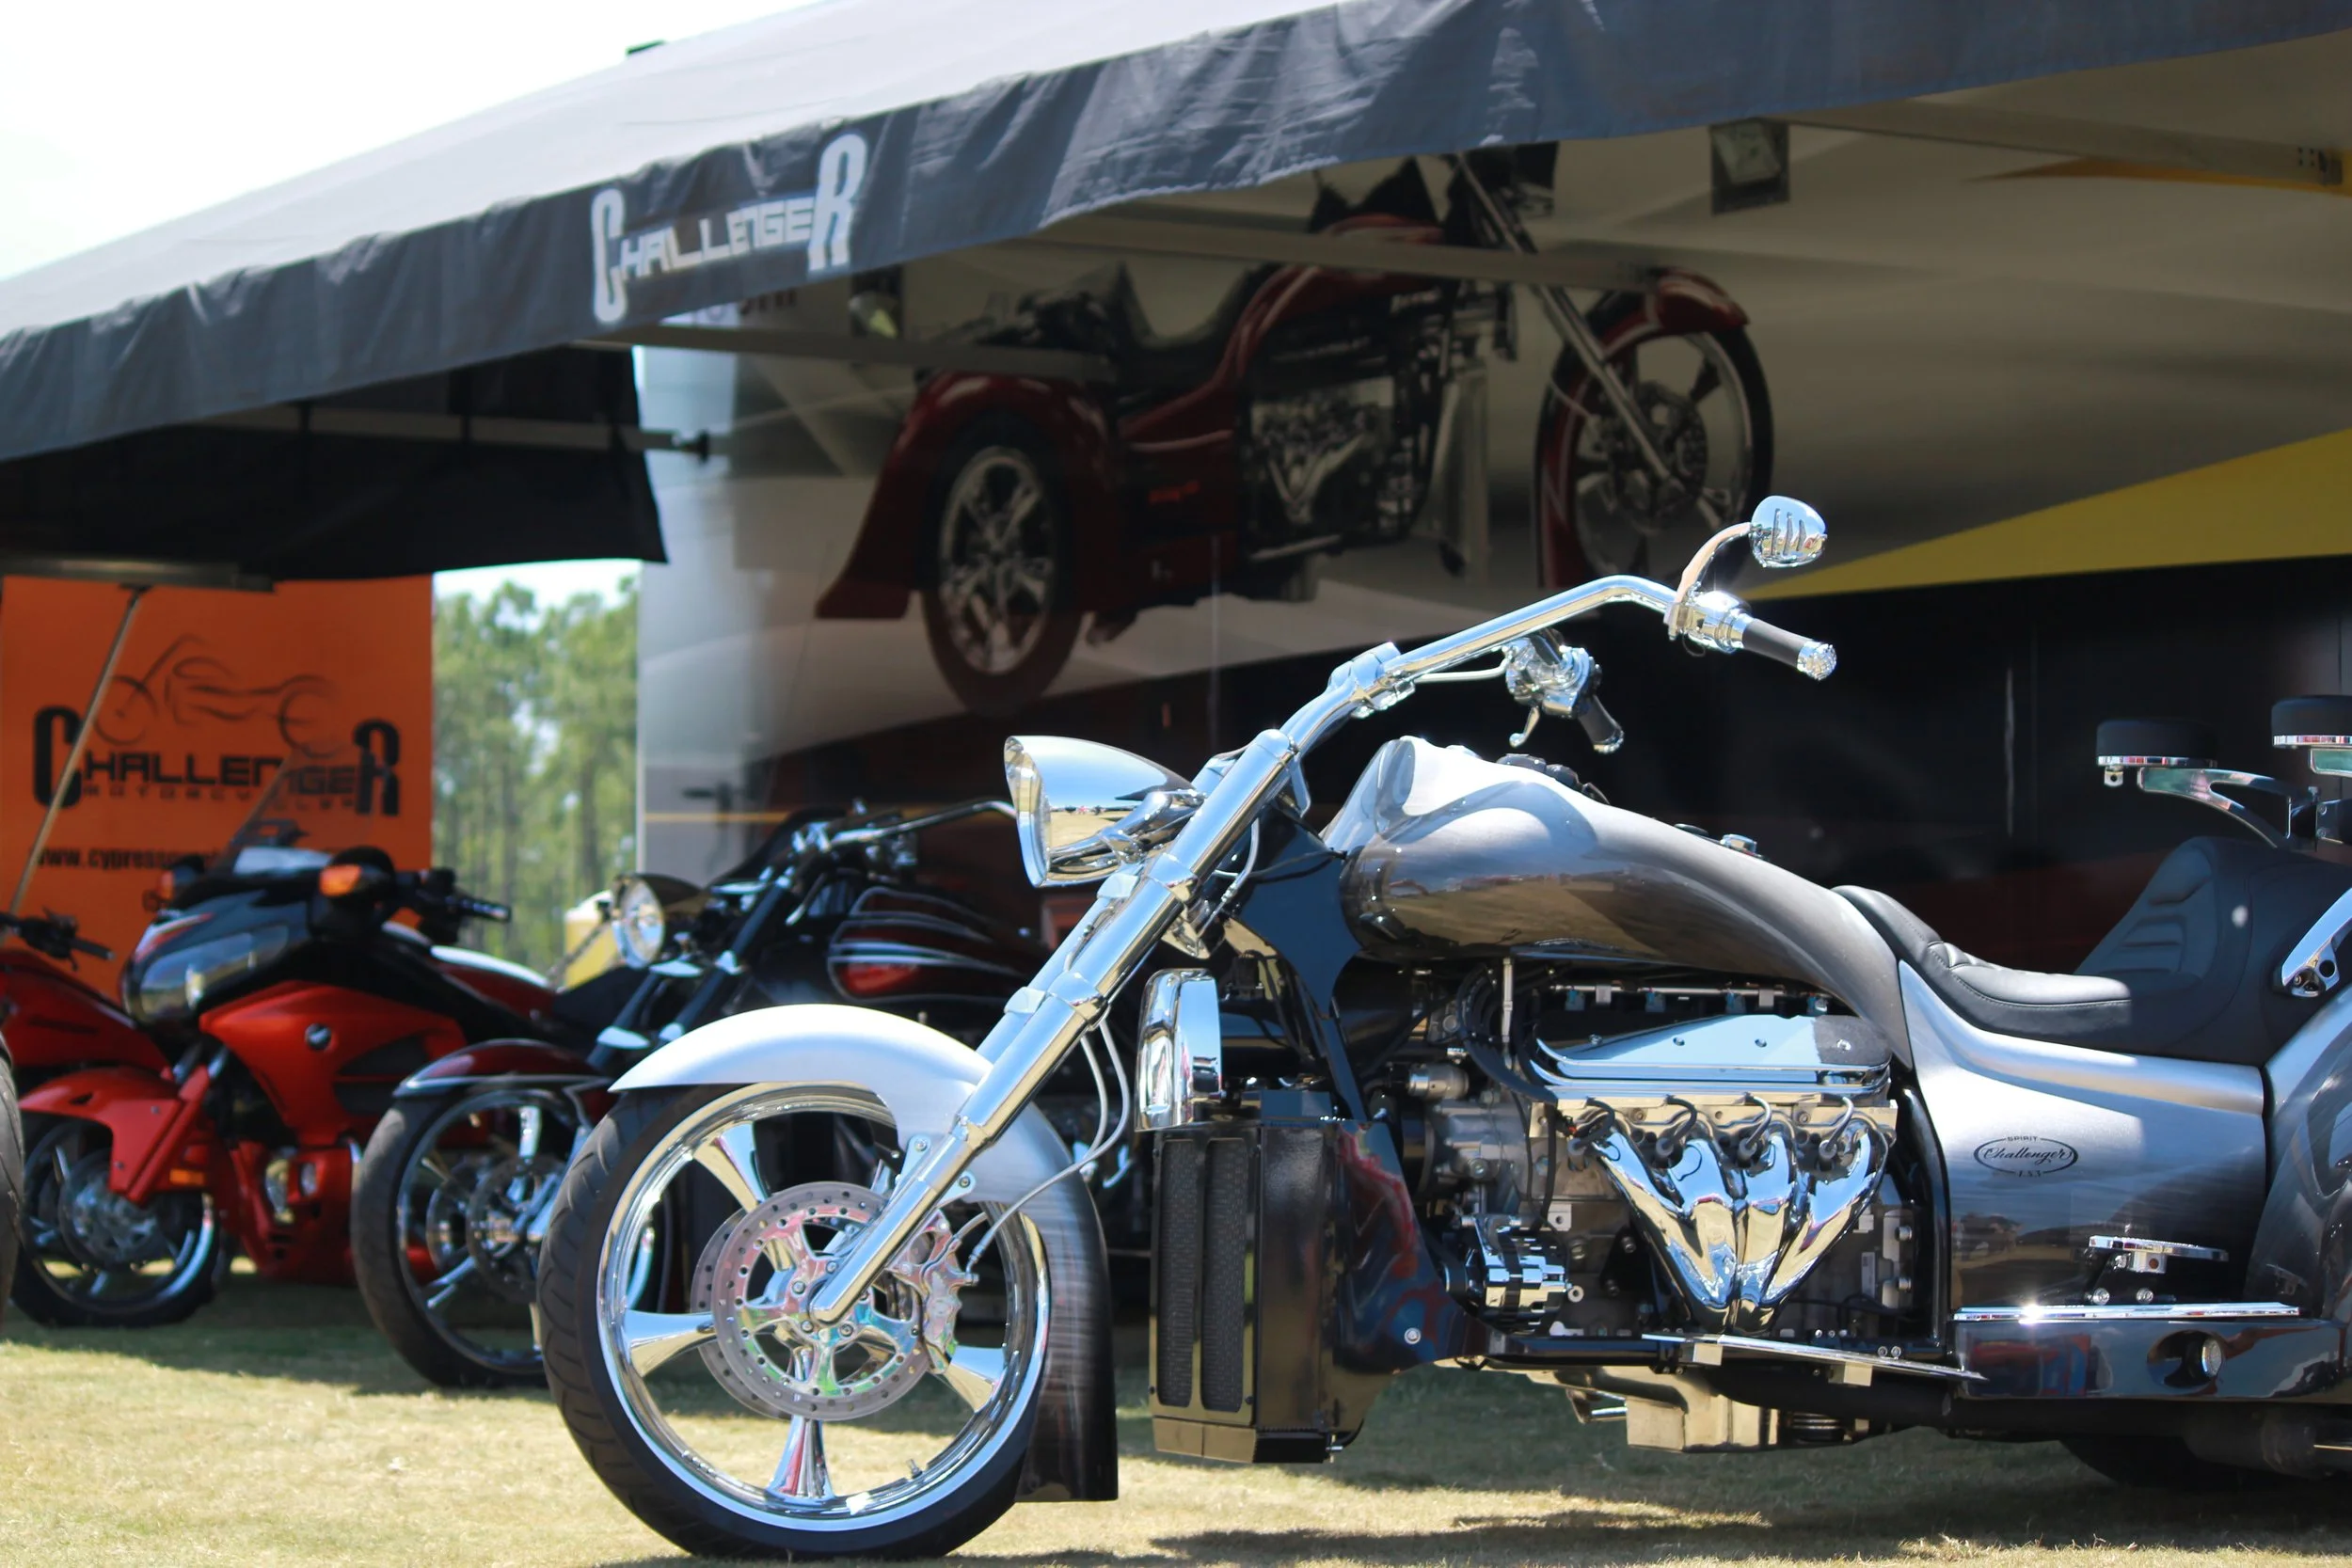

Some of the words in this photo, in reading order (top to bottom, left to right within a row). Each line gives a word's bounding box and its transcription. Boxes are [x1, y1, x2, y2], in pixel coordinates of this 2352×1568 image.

[591, 133, 868, 323] CHALLENGER
[33, 705, 400, 816] CHALLENGER
[1981, 1146, 2073, 1165] Challenger
